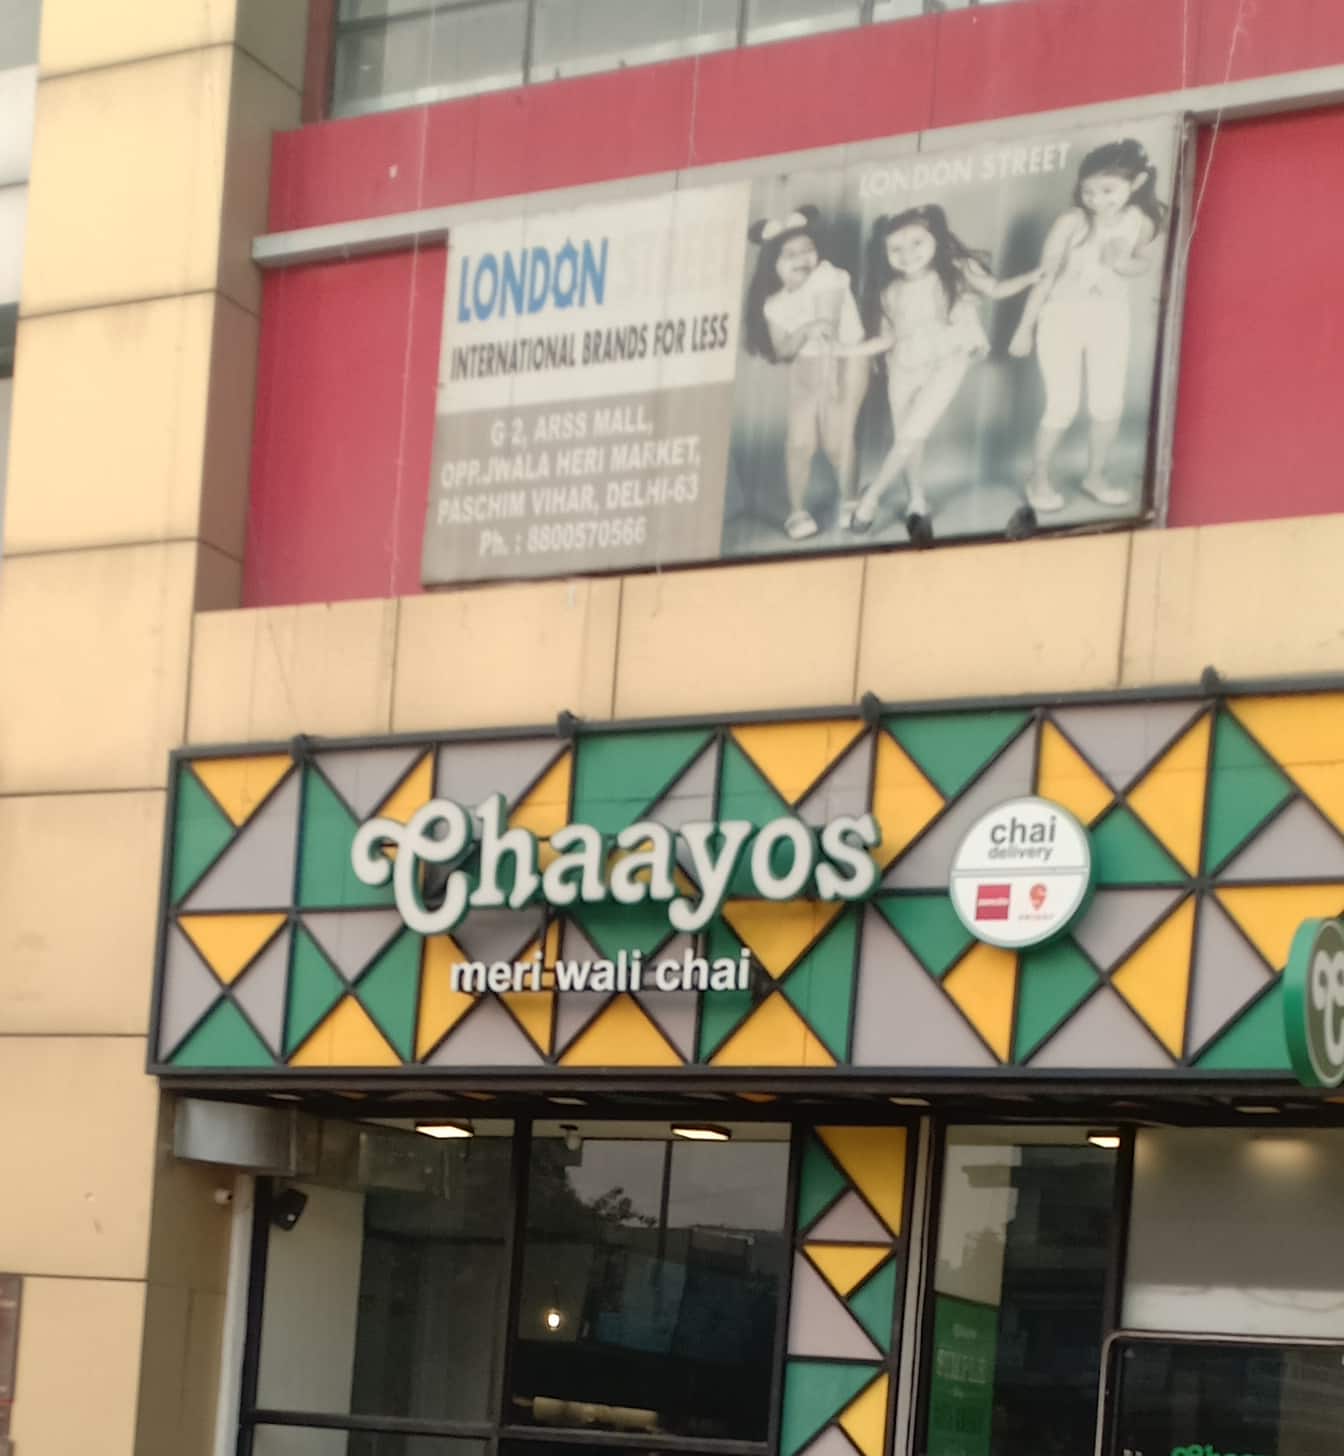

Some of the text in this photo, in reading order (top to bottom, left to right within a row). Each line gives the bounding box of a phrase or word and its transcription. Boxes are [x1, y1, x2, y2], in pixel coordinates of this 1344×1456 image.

[859, 142, 1072, 199] LONDON STREET
[457, 236, 609, 323] LONDON
[450, 313, 729, 382] INTERNATIONAL BRANDS FOR LESS
[533, 411, 587, 441] ARSS
[593, 404, 654, 436] MALL,
[555, 447, 604, 477] HERI
[437, 473, 699, 525] PASCHIM VIHAR, DELHI-63
[987, 846, 1054, 861] delivery
[989, 815, 1056, 845] chai
[351, 793, 881, 935] Chaayos
[450, 946, 751, 993] meri wali chai
